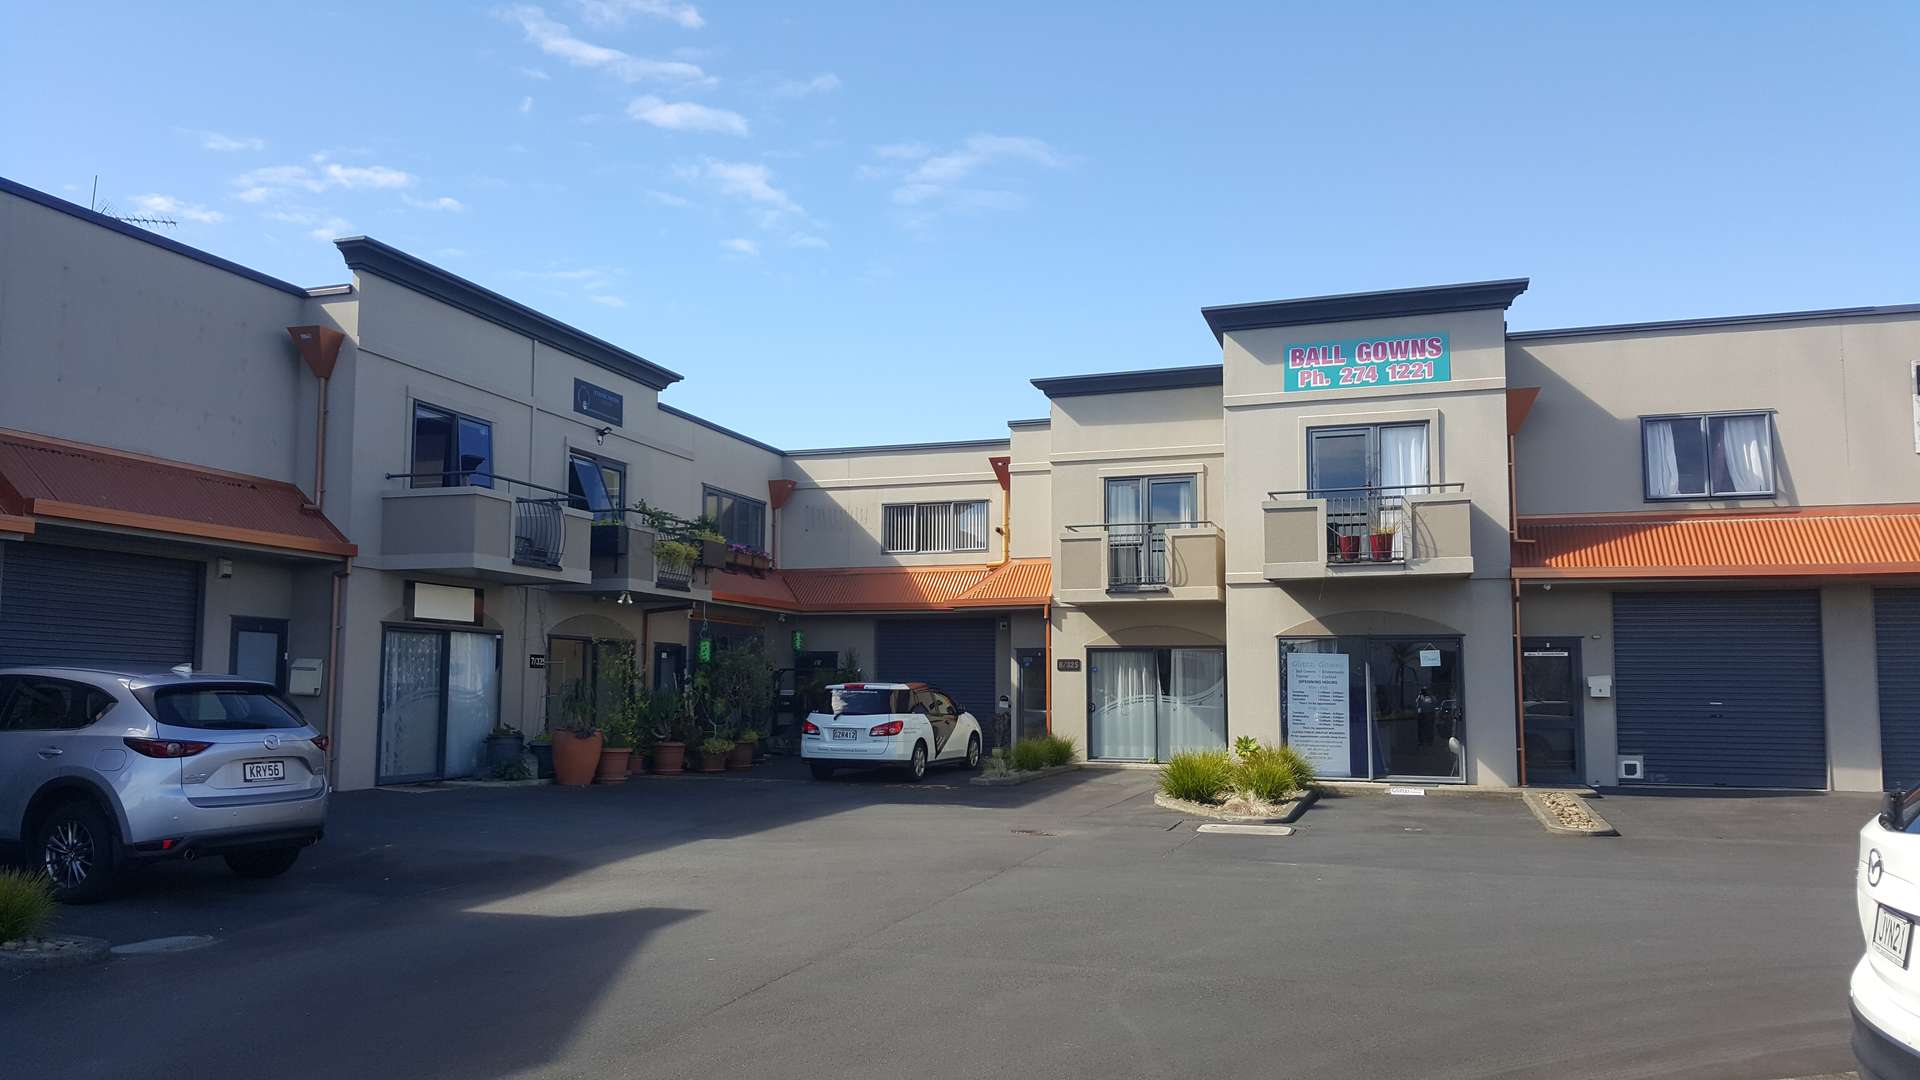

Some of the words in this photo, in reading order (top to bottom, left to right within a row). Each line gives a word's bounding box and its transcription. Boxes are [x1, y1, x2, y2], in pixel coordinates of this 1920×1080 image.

[1289, 346, 1346, 369] BALL
[1355, 337, 1443, 363] GOWNS
[1298, 370, 1330, 387] Ph.
[1339, 365, 1378, 385] 274
[1387, 361, 1434, 381] 1221
[250, 765, 279, 778] KRY56
[1879, 913, 1905, 954] JYN21
